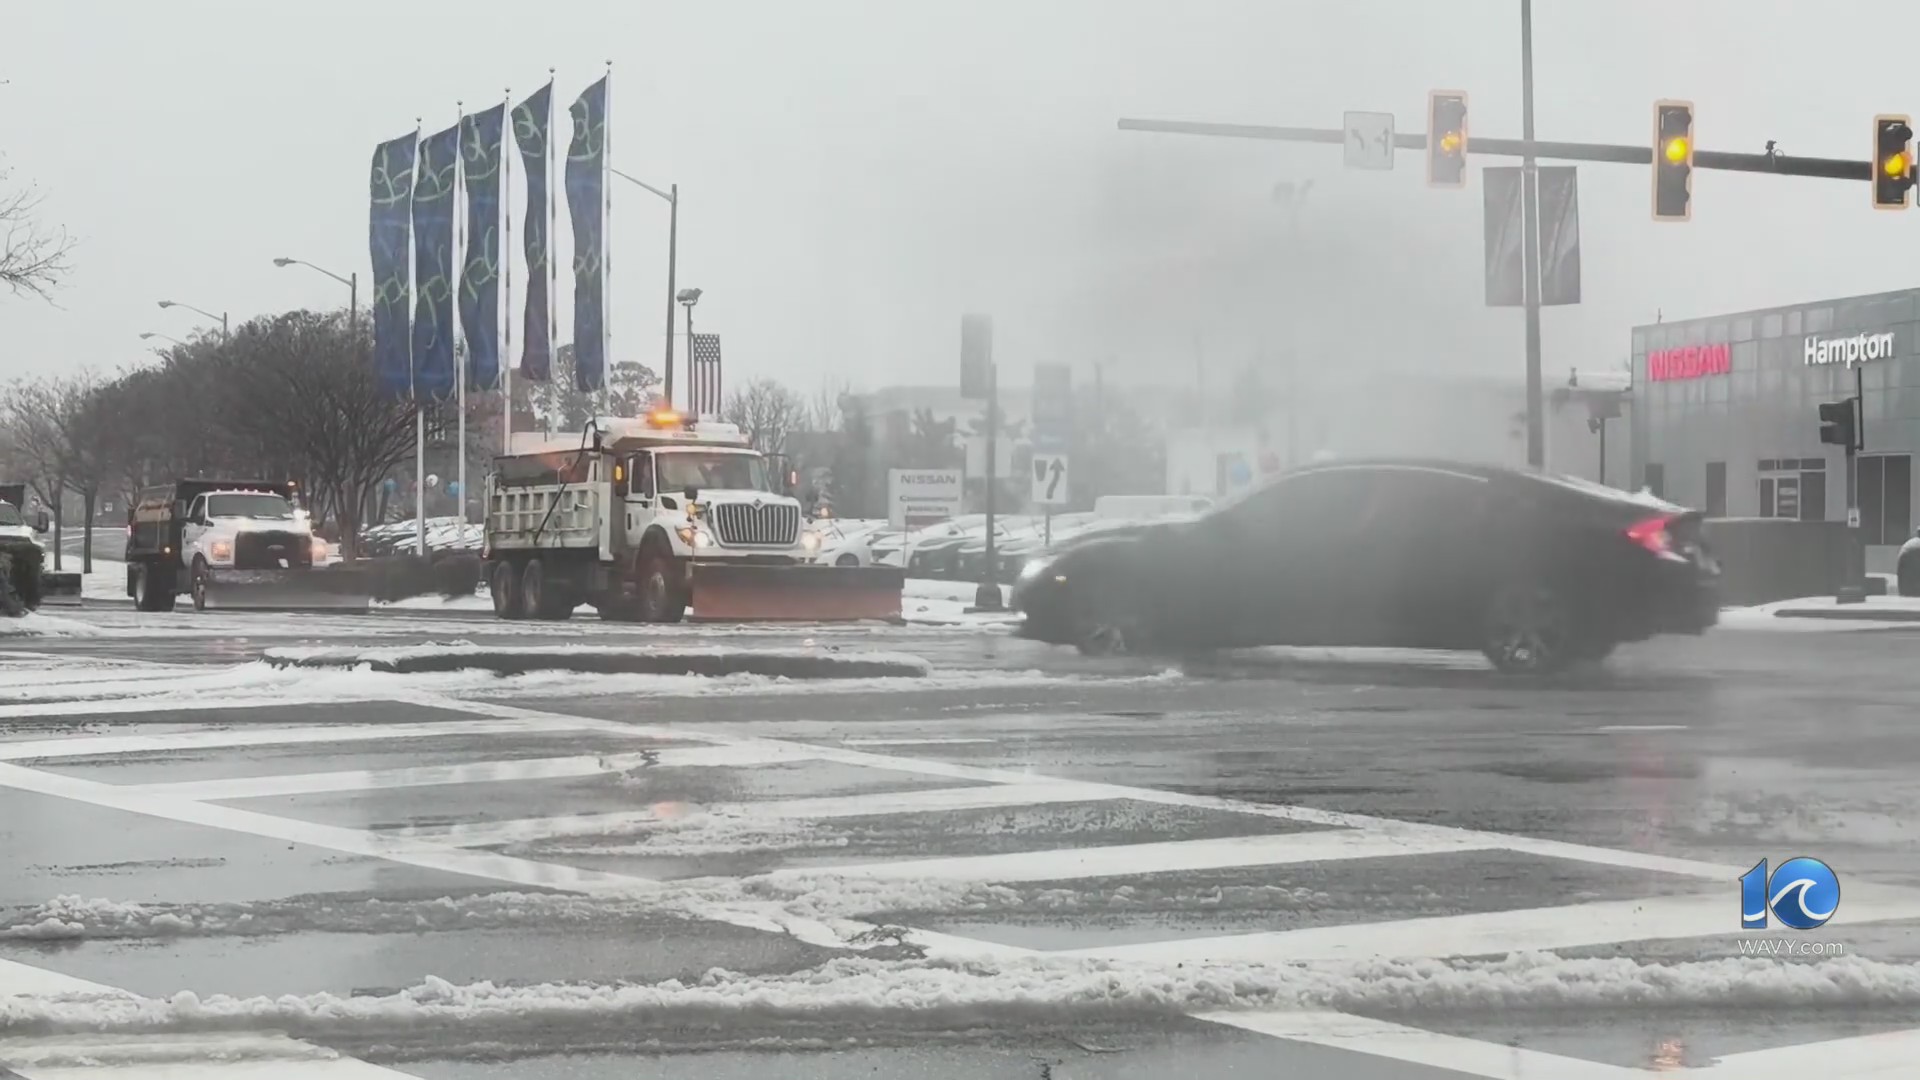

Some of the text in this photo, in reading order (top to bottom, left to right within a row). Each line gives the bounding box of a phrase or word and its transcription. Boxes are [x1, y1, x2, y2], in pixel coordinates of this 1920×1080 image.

[1648, 342, 1730, 381] NISSAN
[1804, 332, 1894, 369] Hampton
[900, 474, 956, 485] NISSAN
